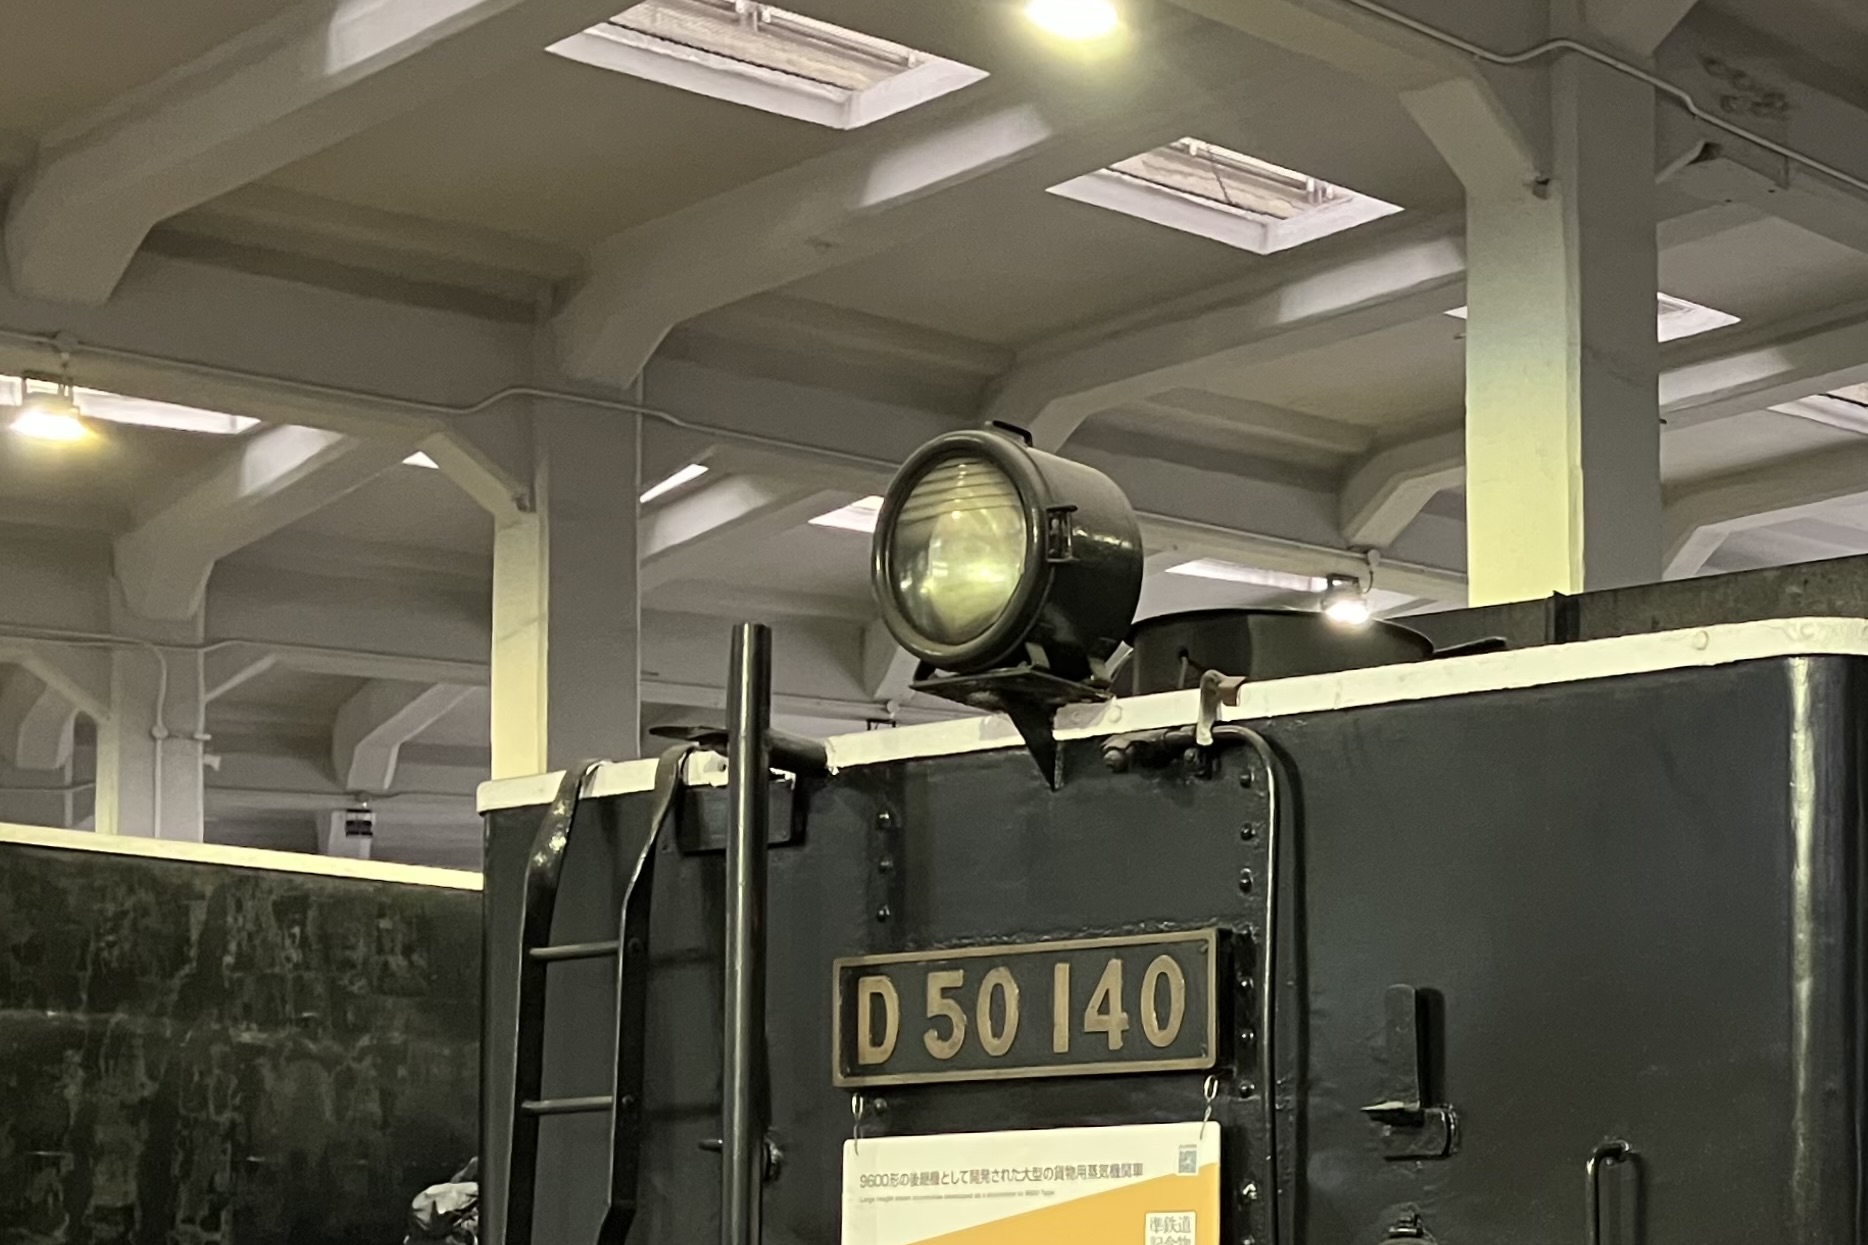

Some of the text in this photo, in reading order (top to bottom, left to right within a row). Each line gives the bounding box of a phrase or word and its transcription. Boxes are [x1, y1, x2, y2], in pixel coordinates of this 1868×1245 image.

[858, 956, 1186, 1065] D 50 140
[1149, 1215, 1191, 1234] 準鉄道
